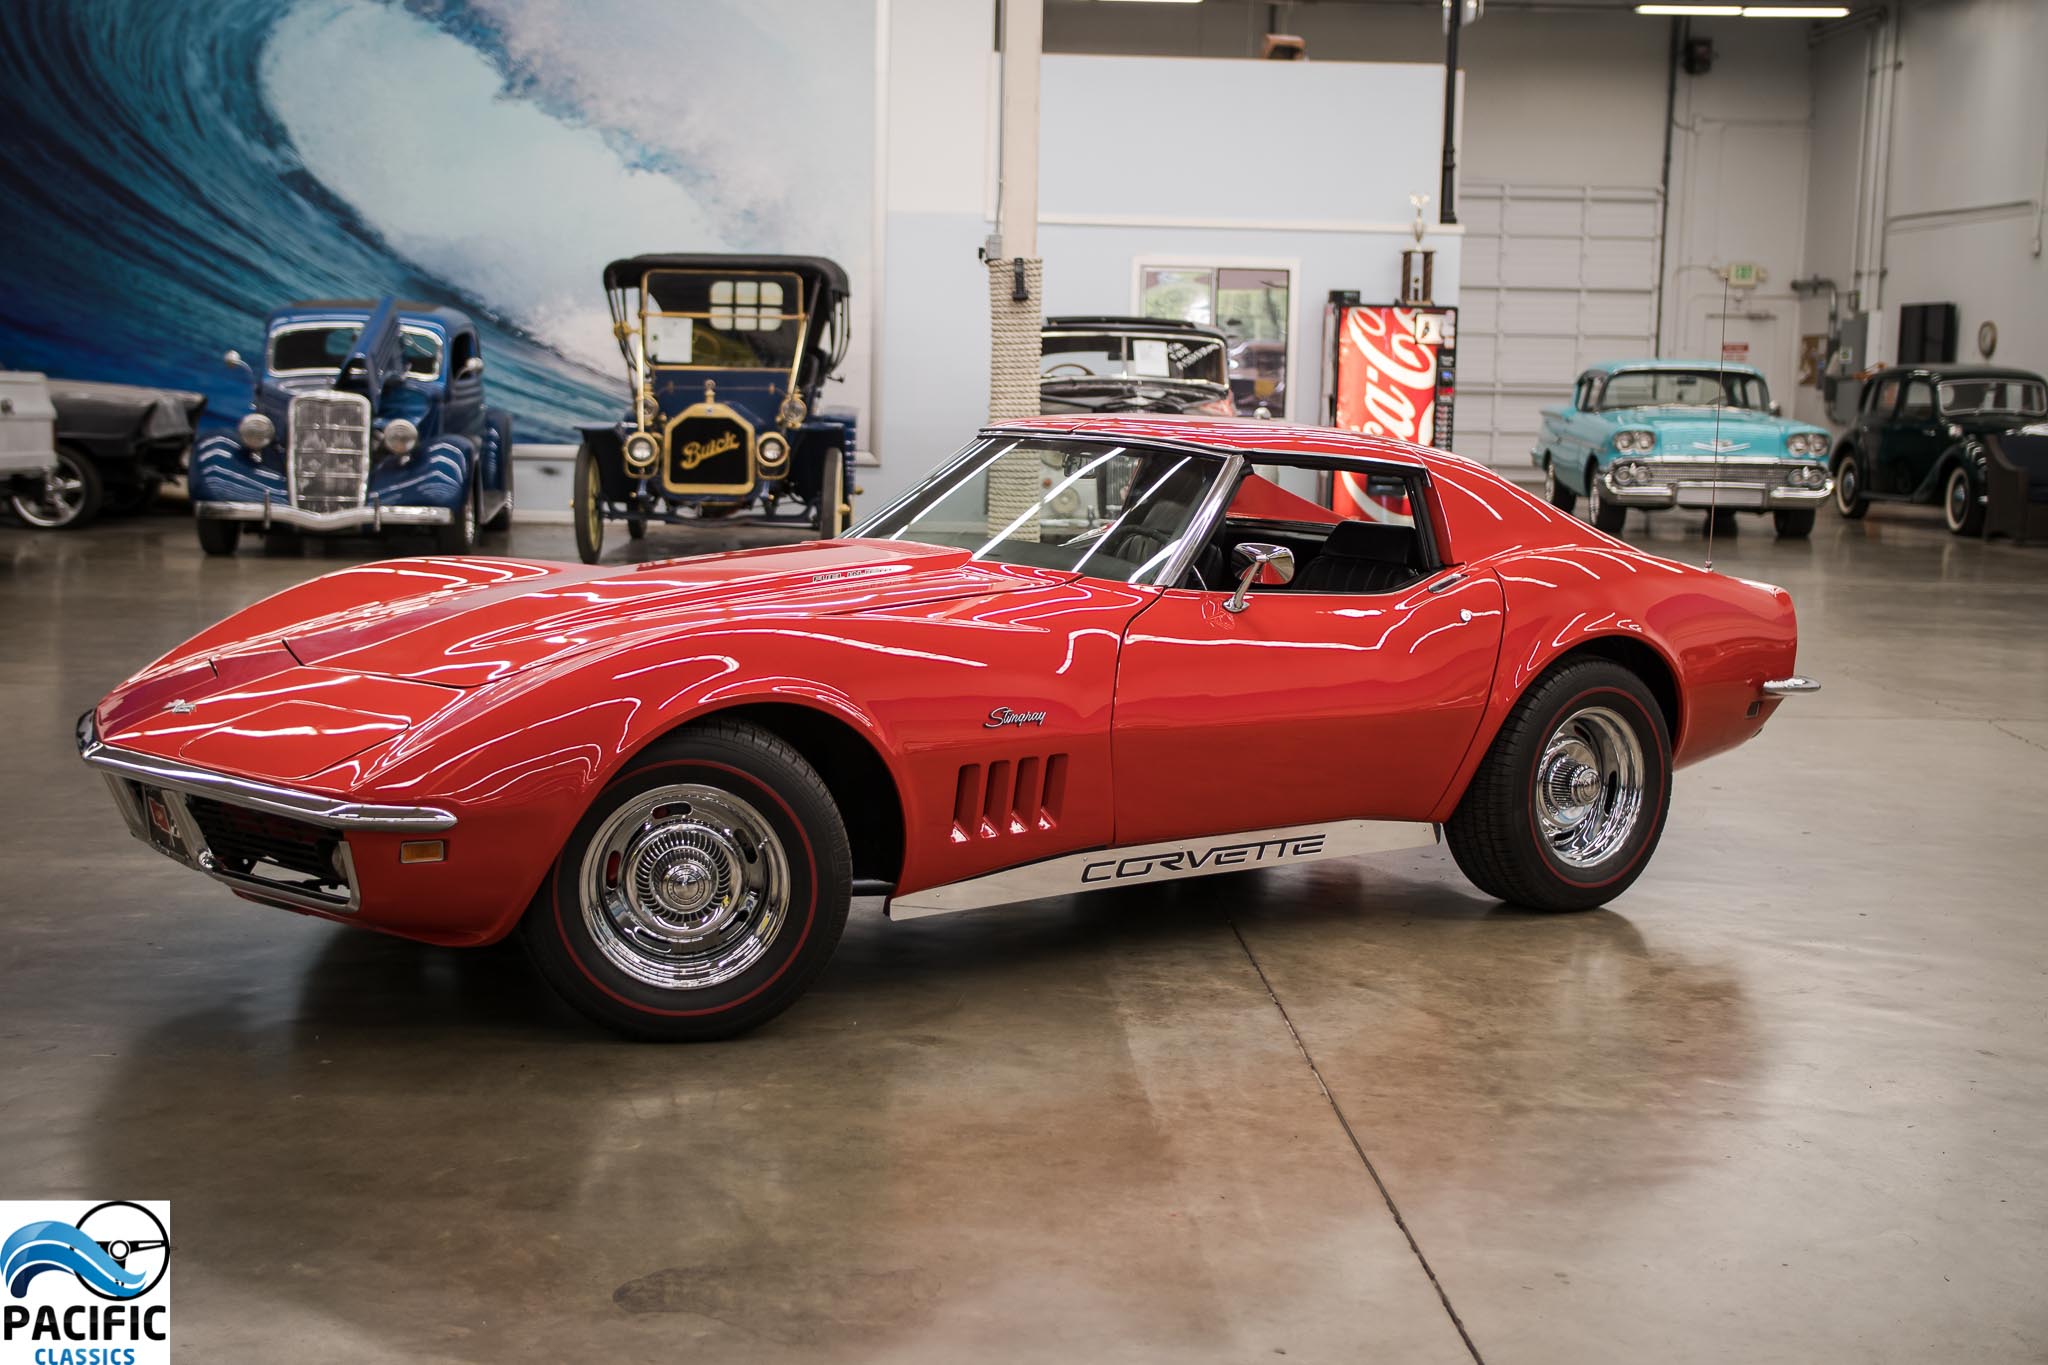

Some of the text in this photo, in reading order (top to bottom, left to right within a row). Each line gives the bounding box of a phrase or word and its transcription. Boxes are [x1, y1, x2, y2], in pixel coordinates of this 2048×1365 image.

[680, 431, 740, 470] Buick
[983, 706, 1047, 728] Stingray
[1081, 834, 1326, 883] CORVETTE
